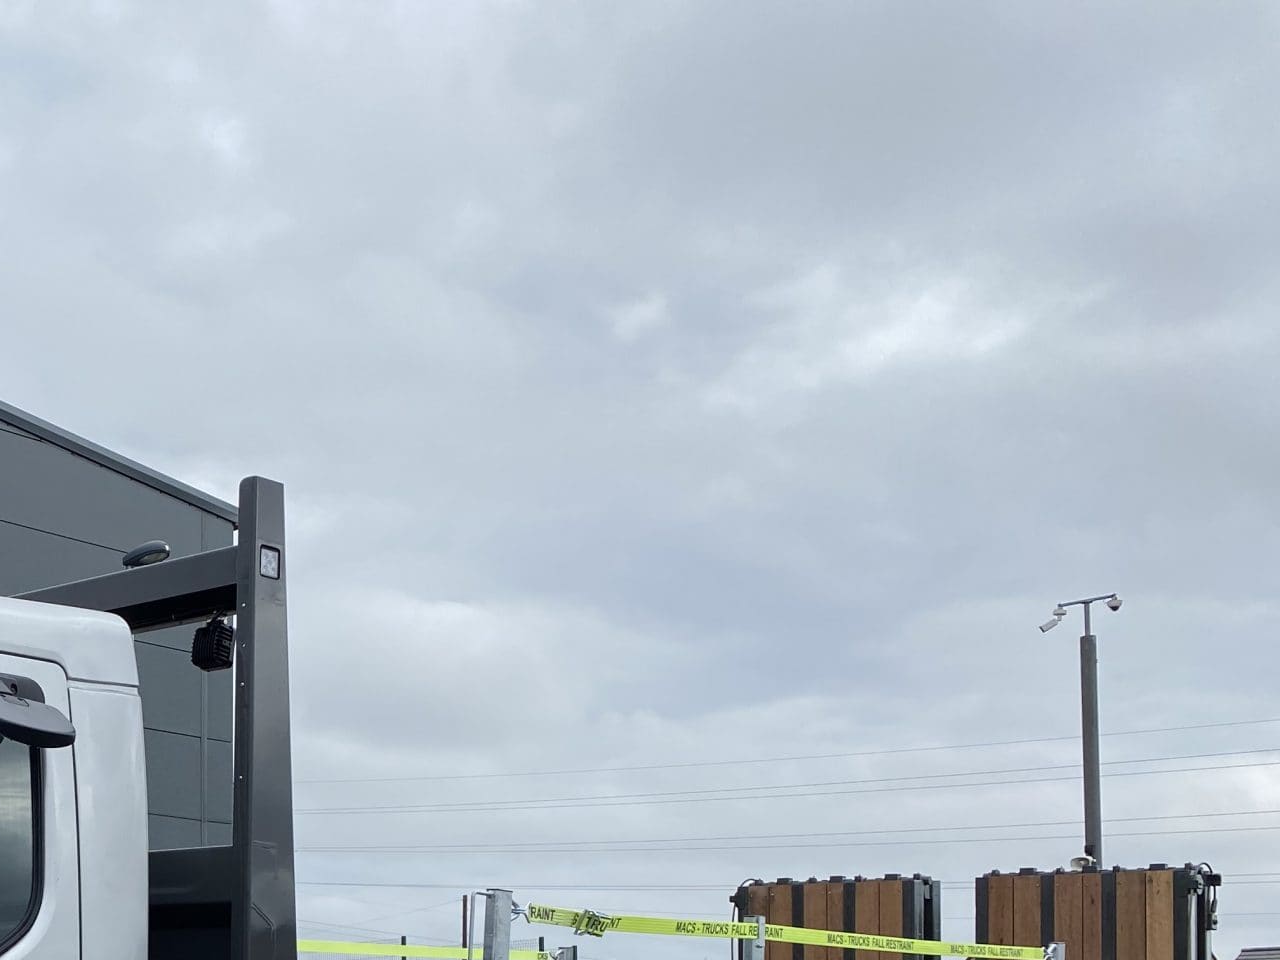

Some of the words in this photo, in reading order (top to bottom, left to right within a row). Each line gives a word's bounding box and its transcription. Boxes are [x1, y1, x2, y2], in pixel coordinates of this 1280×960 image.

[528, 906, 556, 922] RAINT
[675, 921, 697, 934] MACS
[702, 923, 729, 935] TRUCKS
[731, 924, 747, 936] FALL
[748, 925, 784, 939] RERAINT
[827, 933, 844, 945] MACS
[848, 935, 870, 947] TRUCKS
[872, 937, 885, 949] FALL
[886, 939, 914, 951] RESTRAINT
